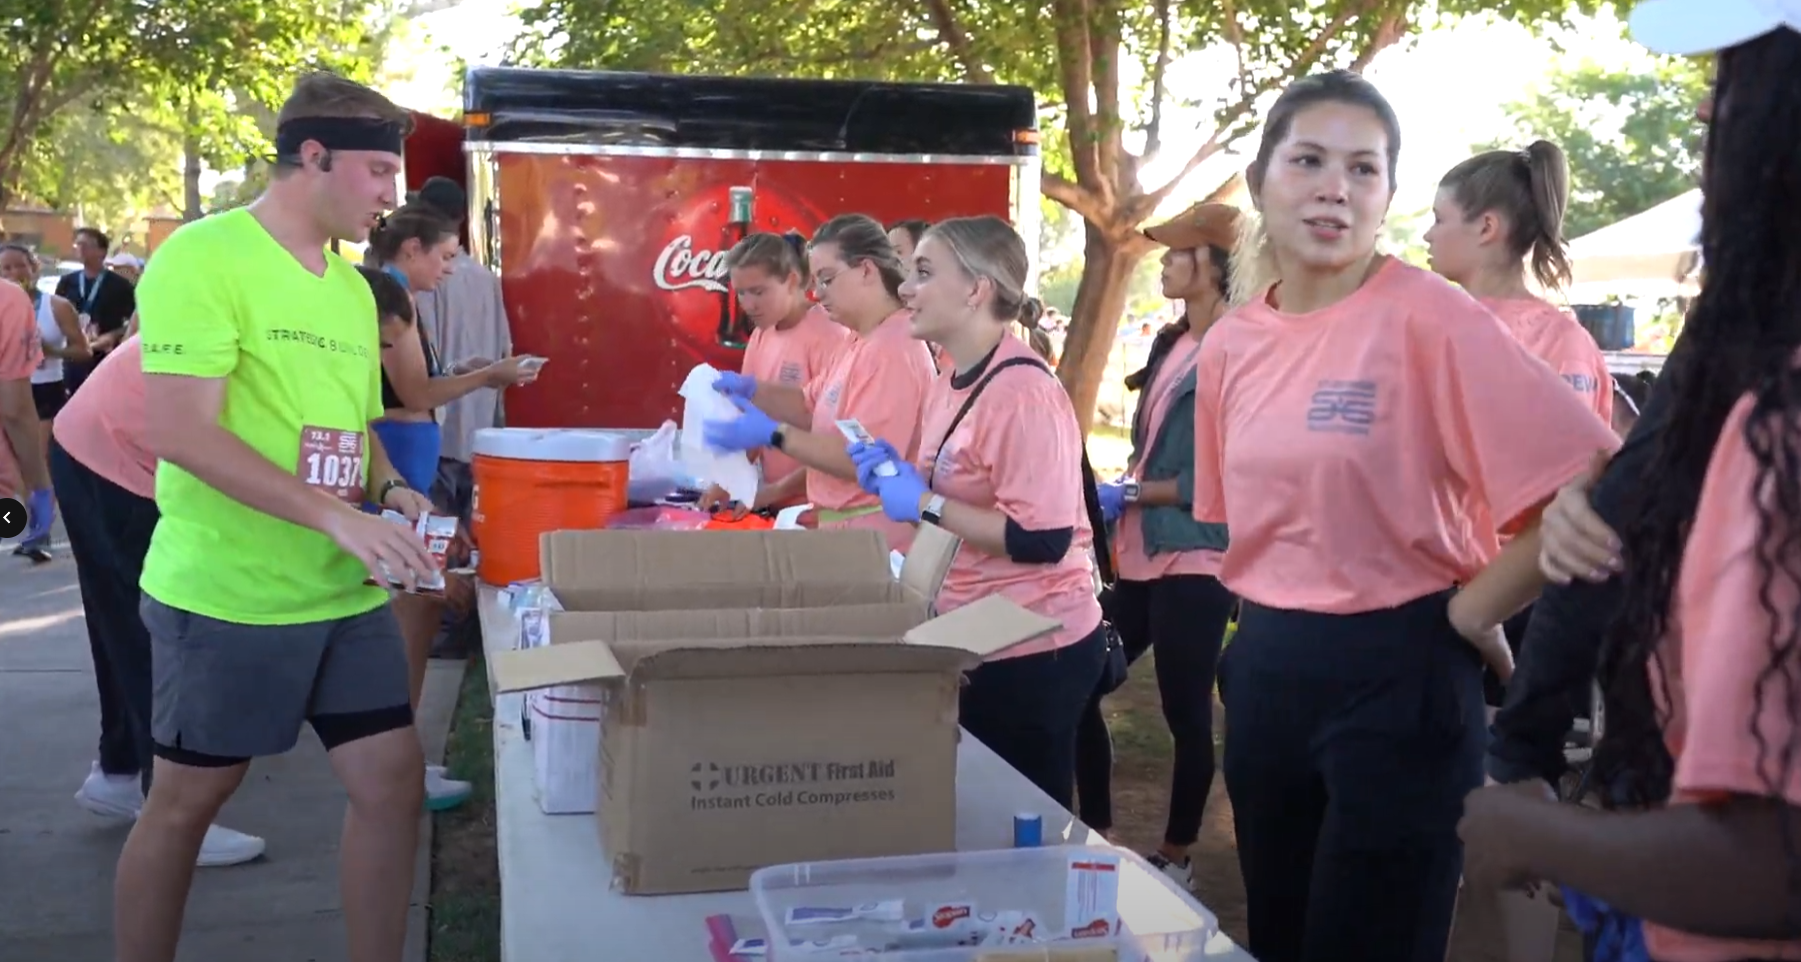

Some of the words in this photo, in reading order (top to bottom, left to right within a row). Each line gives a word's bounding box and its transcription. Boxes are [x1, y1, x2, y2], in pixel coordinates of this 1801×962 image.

[723, 762, 821, 786] URGENT
[826, 761, 864, 781] First
[868, 759, 895, 778] Aid
[691, 793, 751, 810] Instant
[755, 791, 793, 807] Cold
[796, 788, 895, 806] Compresses
